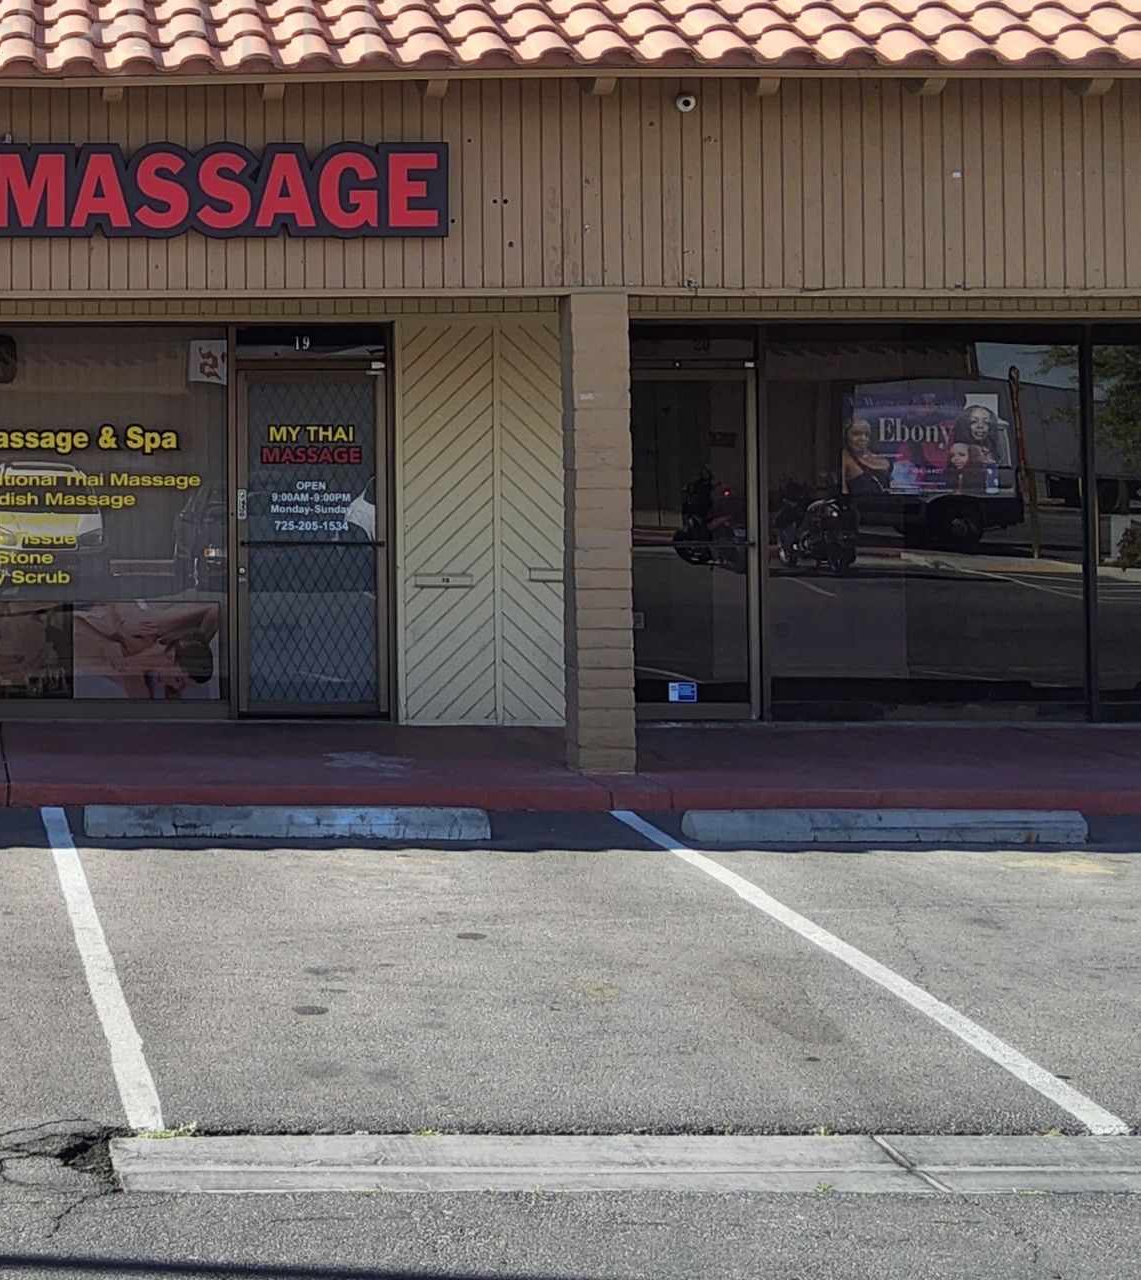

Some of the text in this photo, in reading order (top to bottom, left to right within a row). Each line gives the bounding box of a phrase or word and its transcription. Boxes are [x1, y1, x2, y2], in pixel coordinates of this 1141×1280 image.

[294, 336, 310, 351] 19
[98, 425, 118, 449] &
[126, 426, 178, 453] Spa
[269, 426, 355, 442] MY THAI
[878, 417, 954, 449] Ebony
[261, 447, 361, 464] MASSAGE
[64, 473, 105, 487] Thai
[111, 473, 201, 490] Massage
[296, 481, 327, 491] OPEN
[45, 492, 136, 508] Massage
[270, 504, 353, 516] Monday-Sunday
[274, 521, 349, 532] 725-205-1534
[11, 570, 71, 584] Scrub
